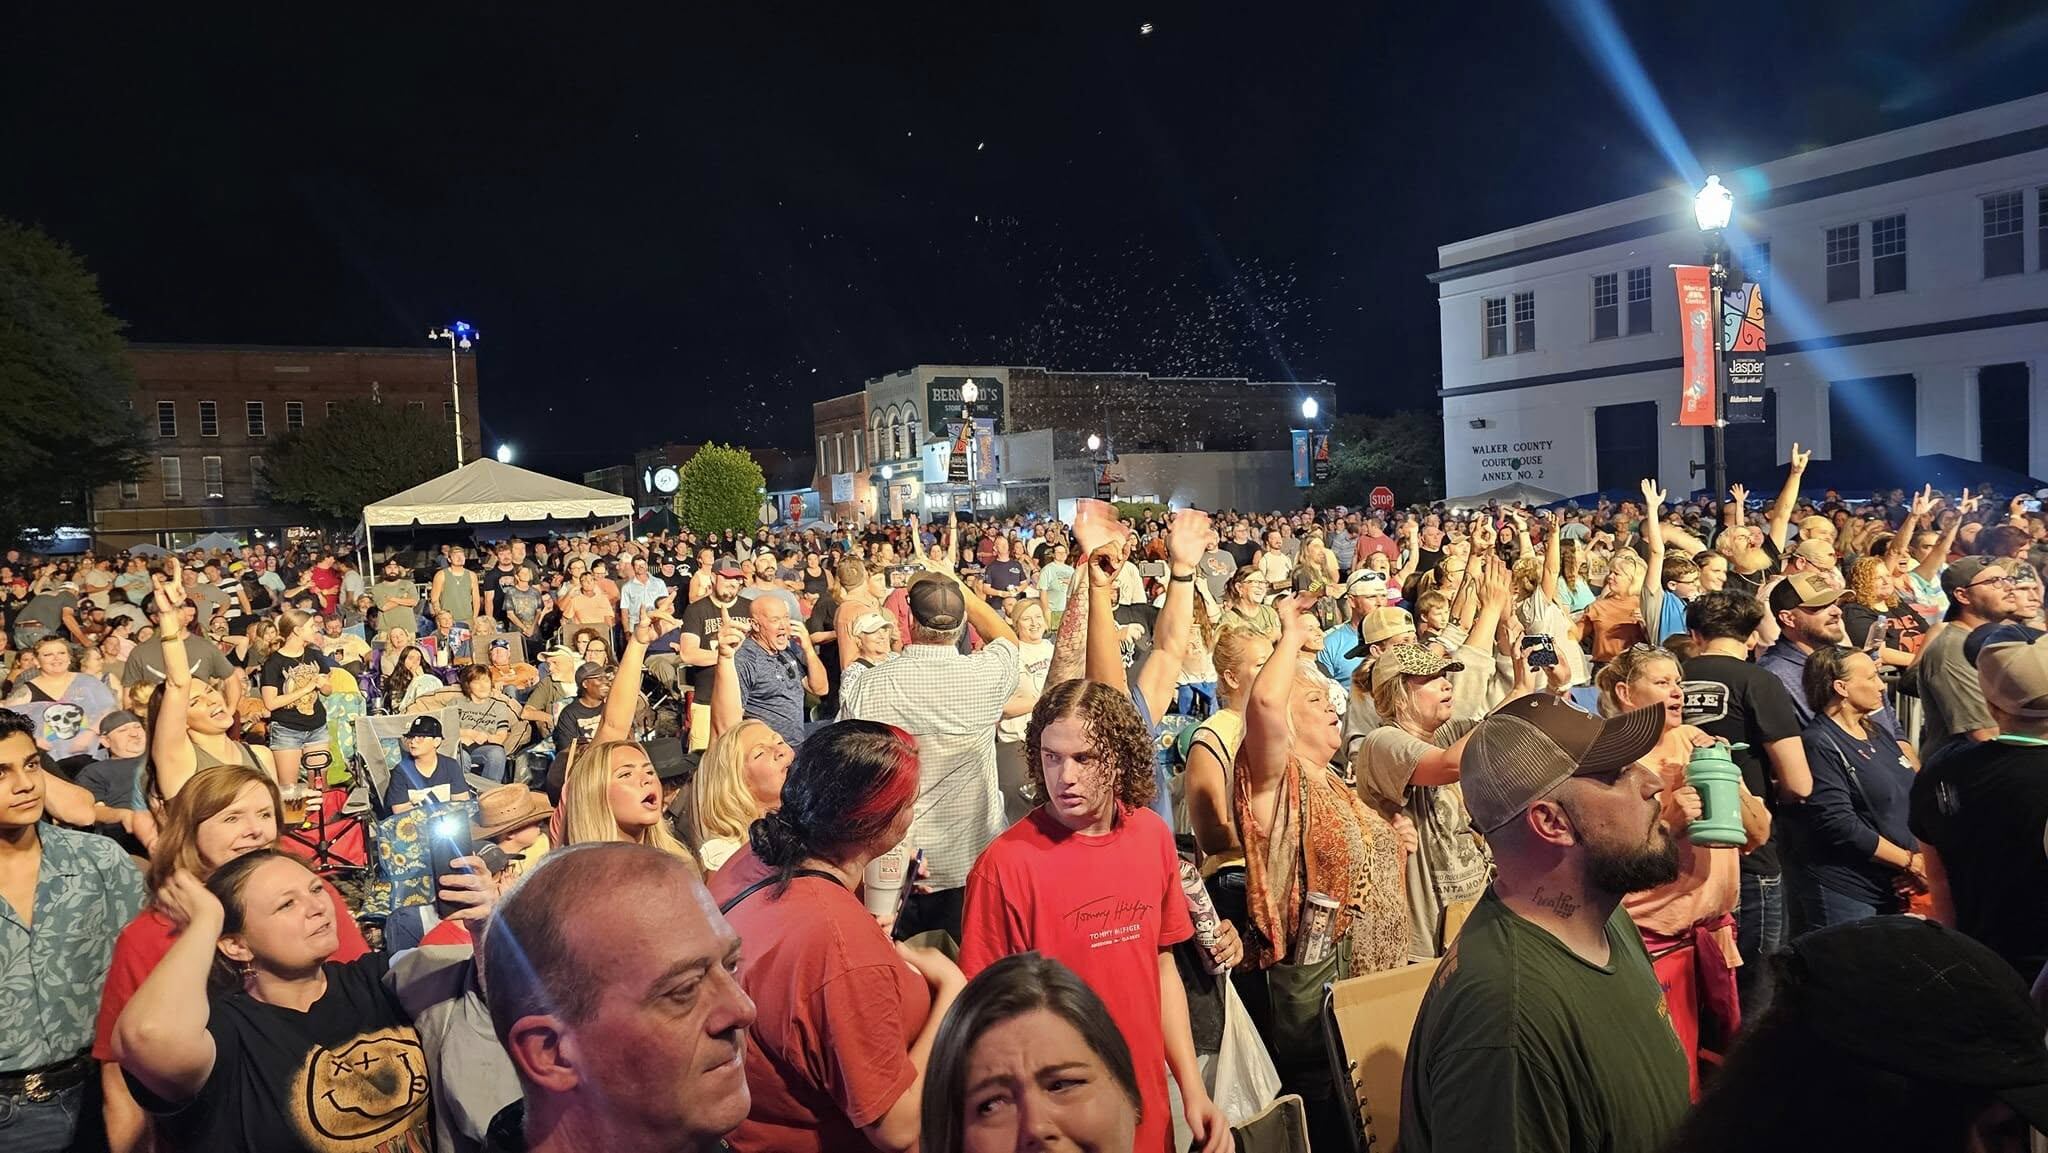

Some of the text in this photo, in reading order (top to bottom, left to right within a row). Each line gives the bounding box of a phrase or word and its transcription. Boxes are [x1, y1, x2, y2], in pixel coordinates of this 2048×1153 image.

[1729, 360, 1764, 375] Jasper
[932, 388, 998, 402] BERND'S
[1472, 440, 1553, 455] WALKER COUNTY
[1481, 469, 1544, 482] ANNEX NO. 2
[1371, 495, 1393, 505] STOP
[1684, 694, 1718, 707] KE
[1089, 929, 1113, 940] TOMMY
